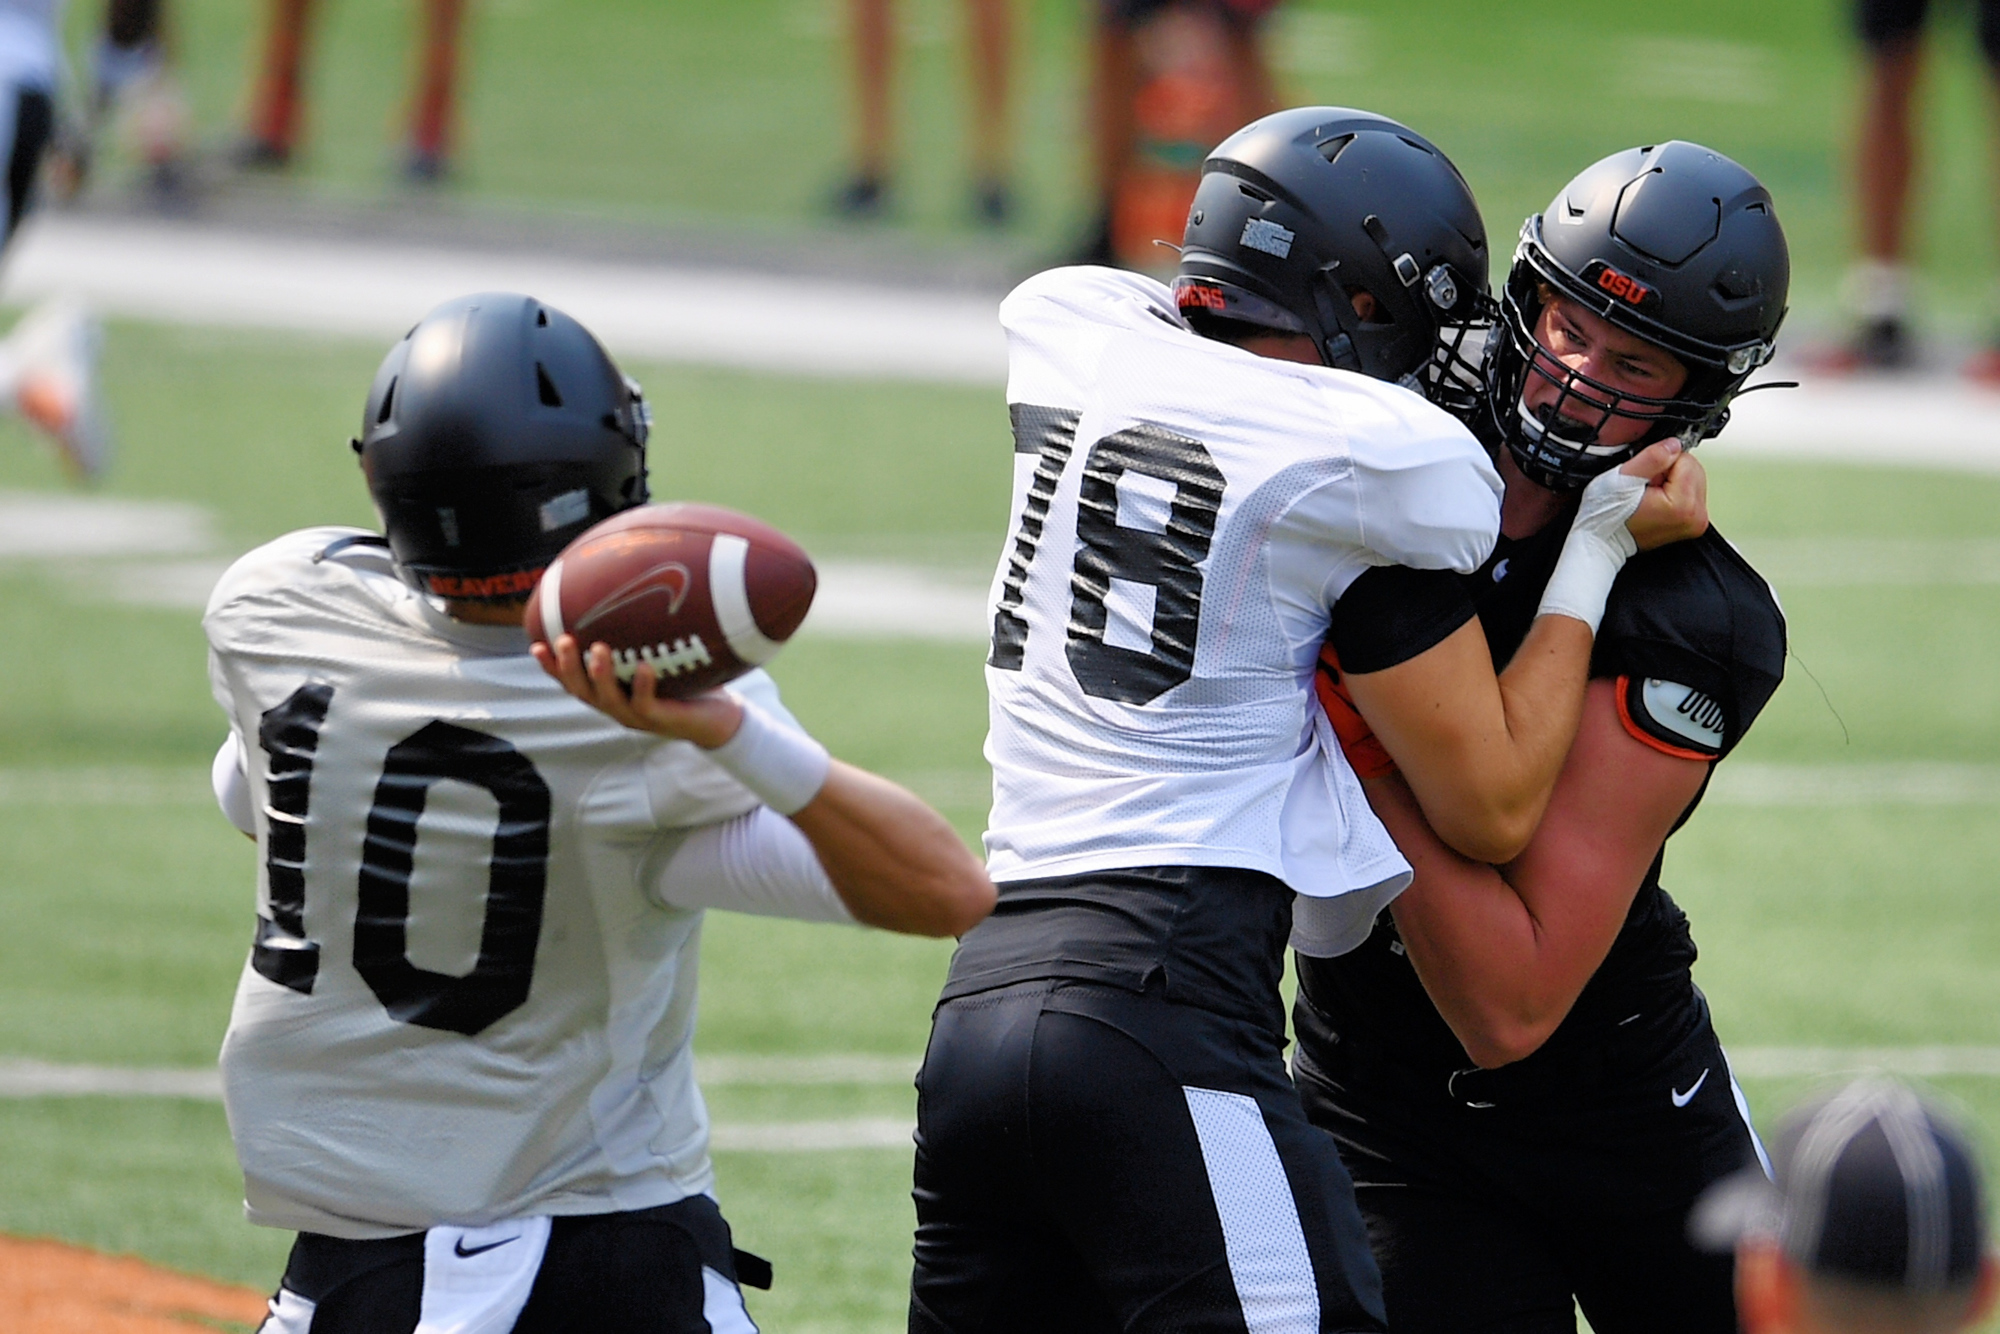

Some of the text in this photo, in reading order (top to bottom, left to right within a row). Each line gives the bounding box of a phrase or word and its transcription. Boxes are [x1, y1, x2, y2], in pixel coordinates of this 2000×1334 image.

[1598, 268, 1647, 305] OSU
[987, 402, 1228, 706] 78
[253, 683, 550, 1035] 10
